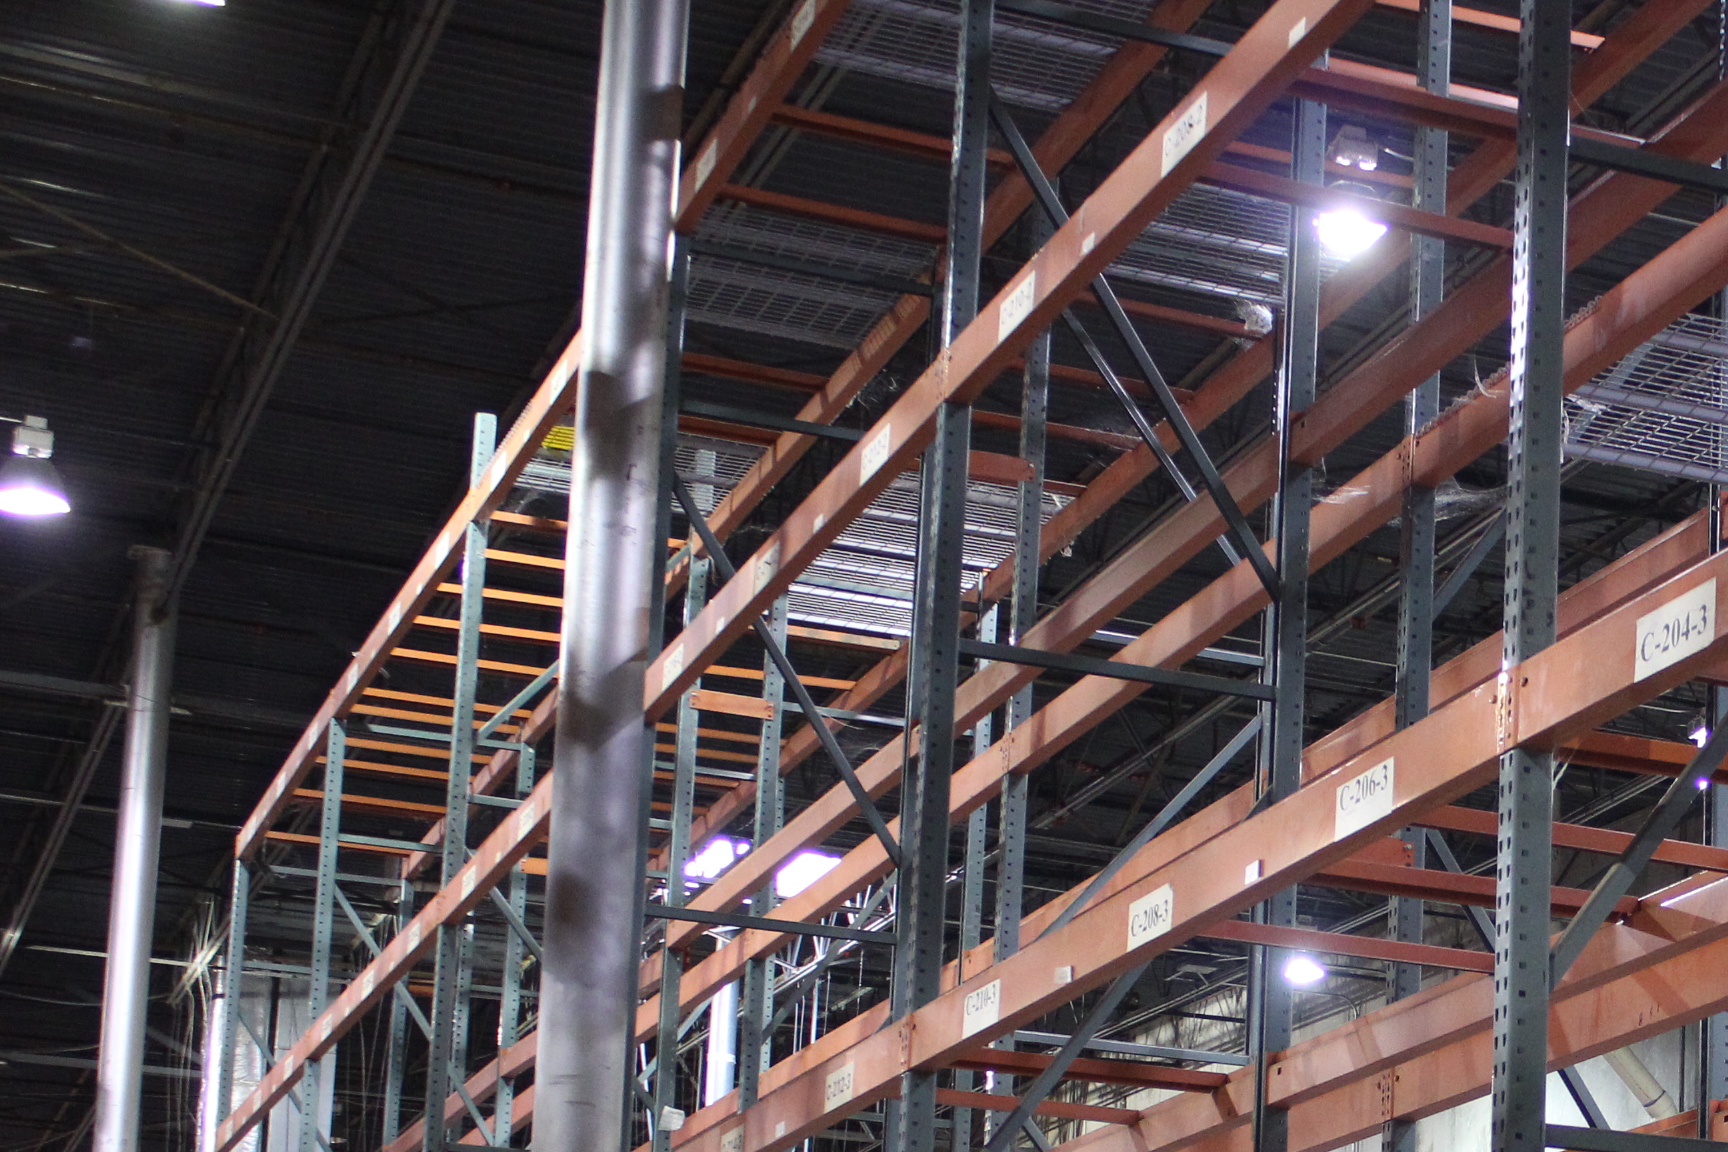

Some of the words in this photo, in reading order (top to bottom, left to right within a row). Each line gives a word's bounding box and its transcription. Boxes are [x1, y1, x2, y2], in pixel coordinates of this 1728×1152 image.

[1641, 604, 1708, 662] C-204-3
[1340, 764, 1388, 811] C-206-3
[1131, 899, 1168, 937] C-208-3
[966, 984, 996, 1016] C-210-3
